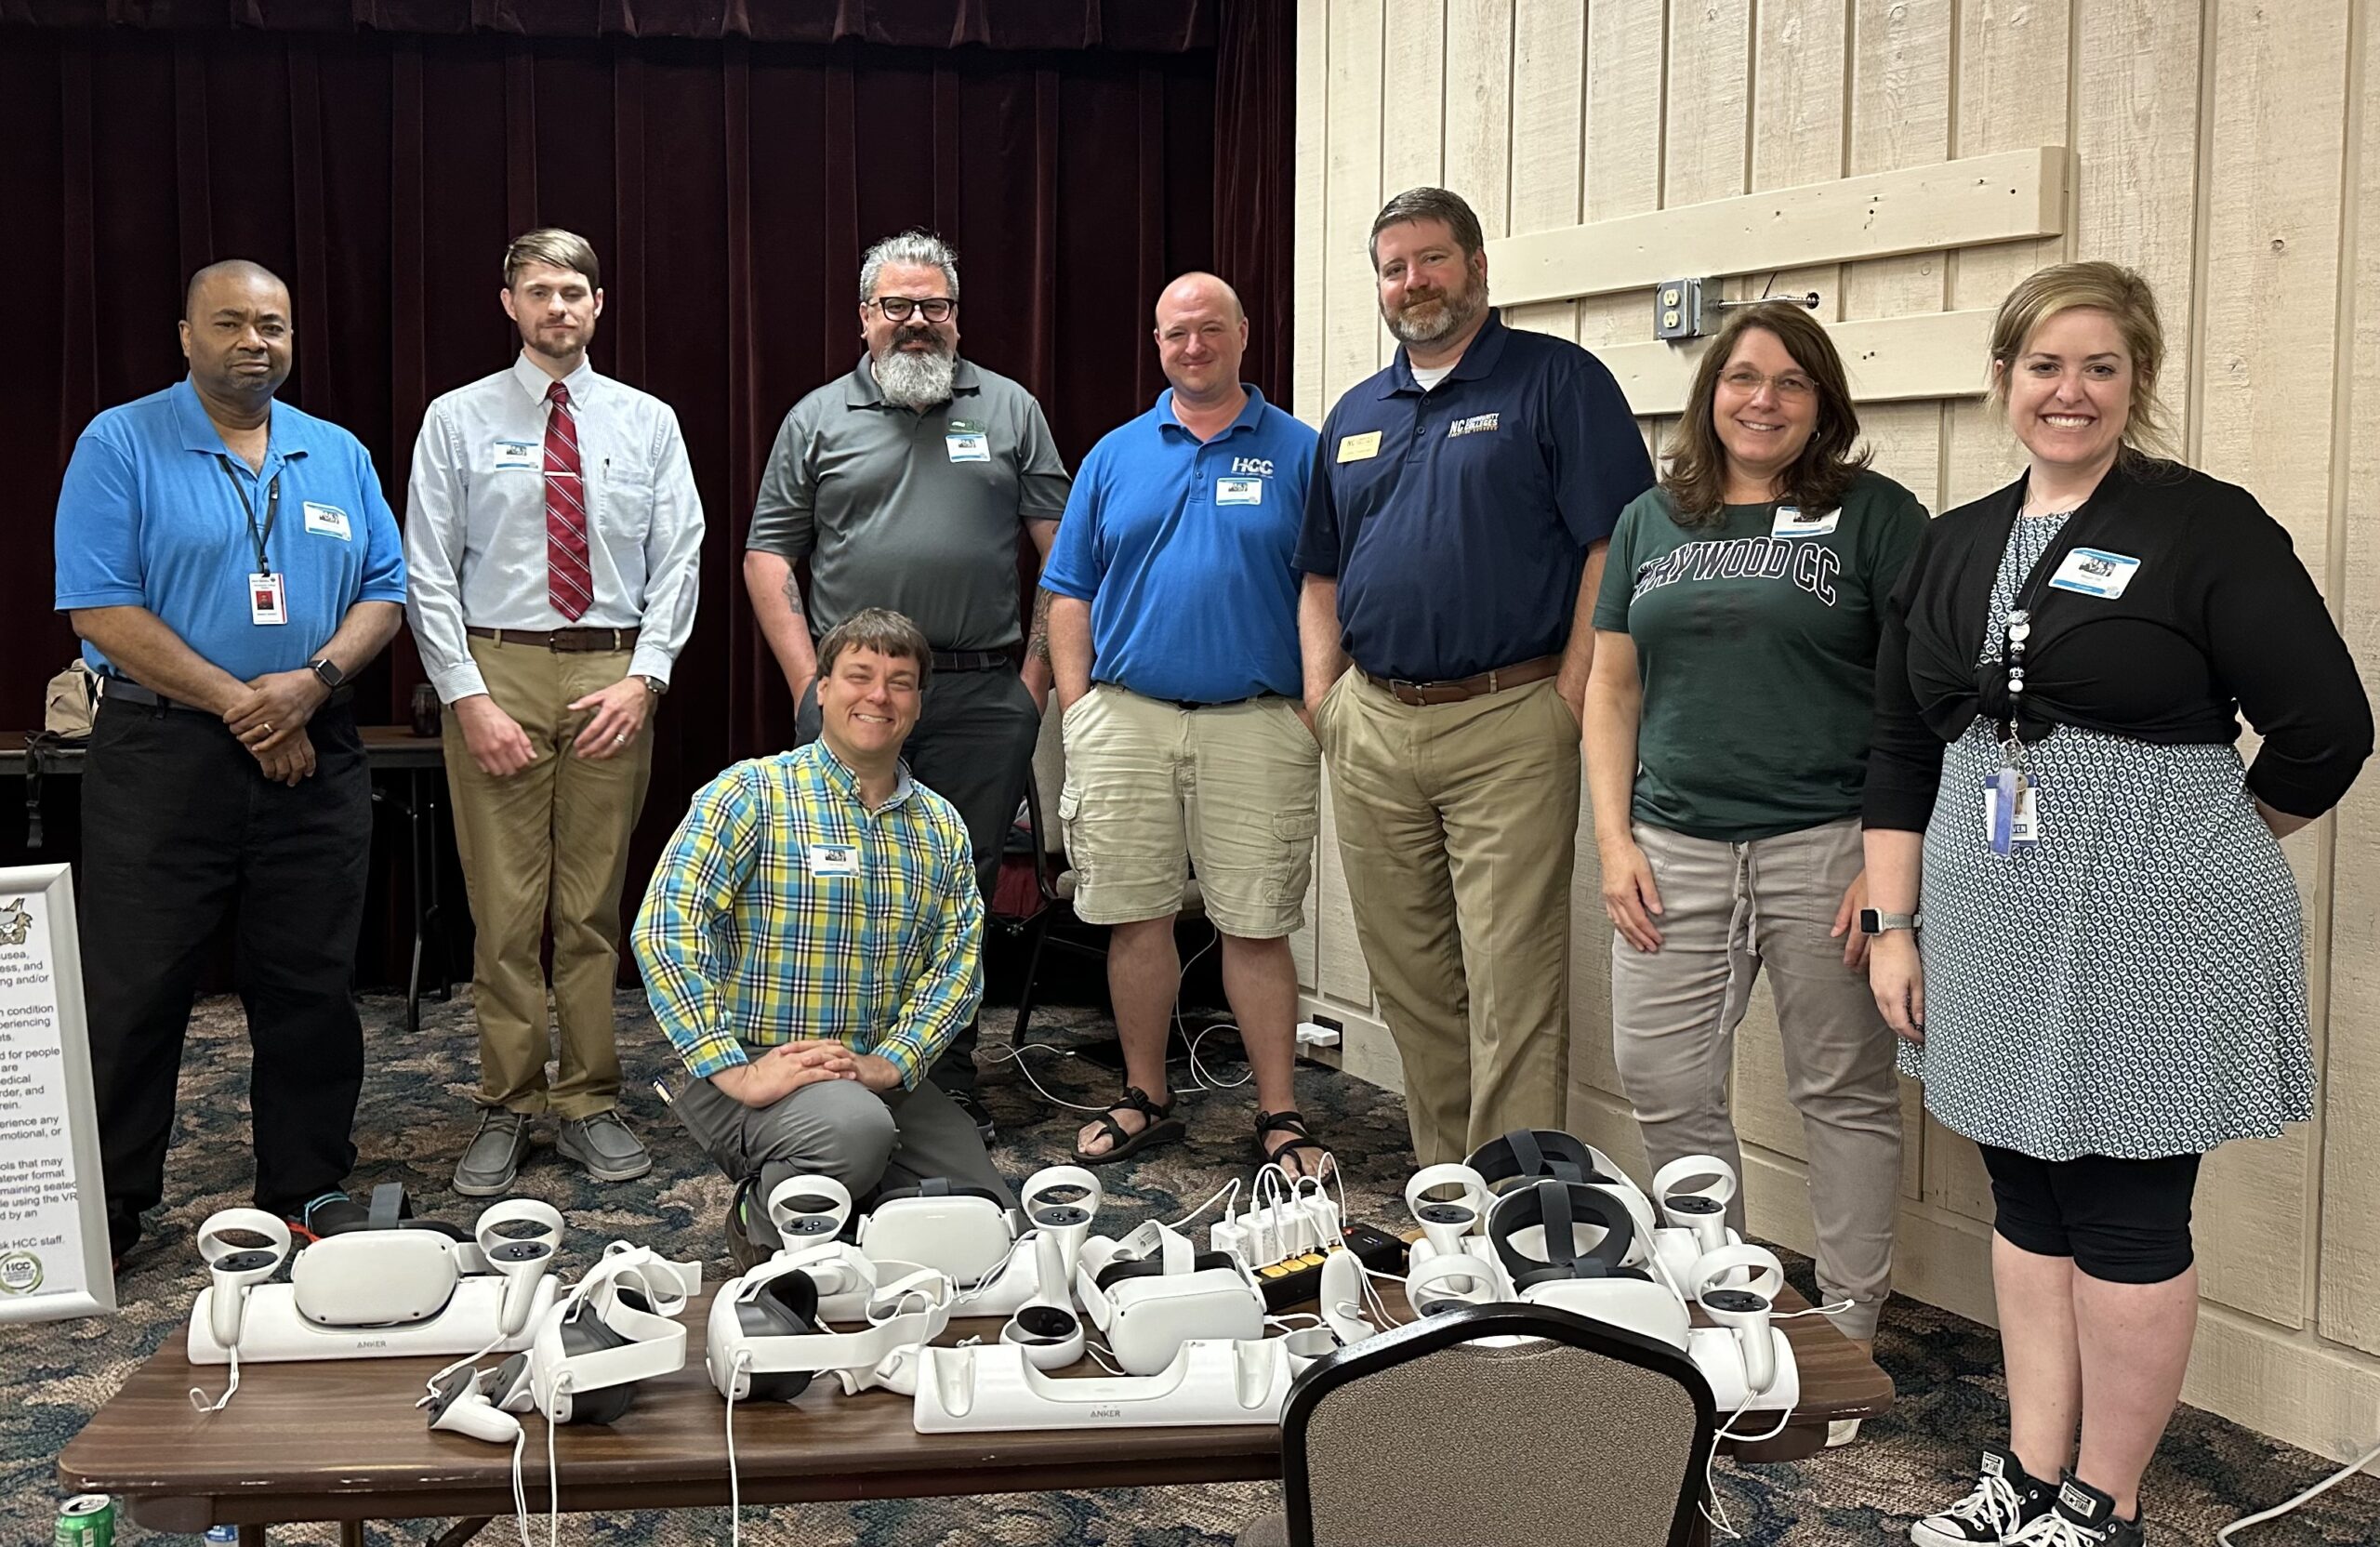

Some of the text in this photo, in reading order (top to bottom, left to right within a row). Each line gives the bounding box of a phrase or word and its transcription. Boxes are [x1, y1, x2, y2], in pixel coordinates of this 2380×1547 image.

[1449, 420, 1466, 435] NC
[1232, 456, 1275, 475] HCC
[1792, 542, 1841, 607] CC
[23, 960, 43, 971] and
[16, 974, 49, 985] and/or
[7, 1005, 54, 1016] condition
[8, 1051, 22, 1059] for
[25, 1047, 60, 1060] people
[25, 1086, 45, 1095] and
[40, 1116, 59, 1126] any
[50, 1128, 62, 1136] or
[18, 1158, 37, 1169] that
[40, 1157, 63, 1168] may
[32, 1169, 65, 1180] format
[12, 1196, 40, 1208] using
[43, 1194, 59, 1204] the
[61, 1192, 78, 1202] VR
[8, 1210, 21, 1221] by
[24, 1210, 37, 1218] an
[12, 1237, 37, 1249] HCC
[40, 1235, 65, 1246] staff.
[7, 1262, 31, 1273] HCC
[1090, 1409, 1120, 1418] ANKER
